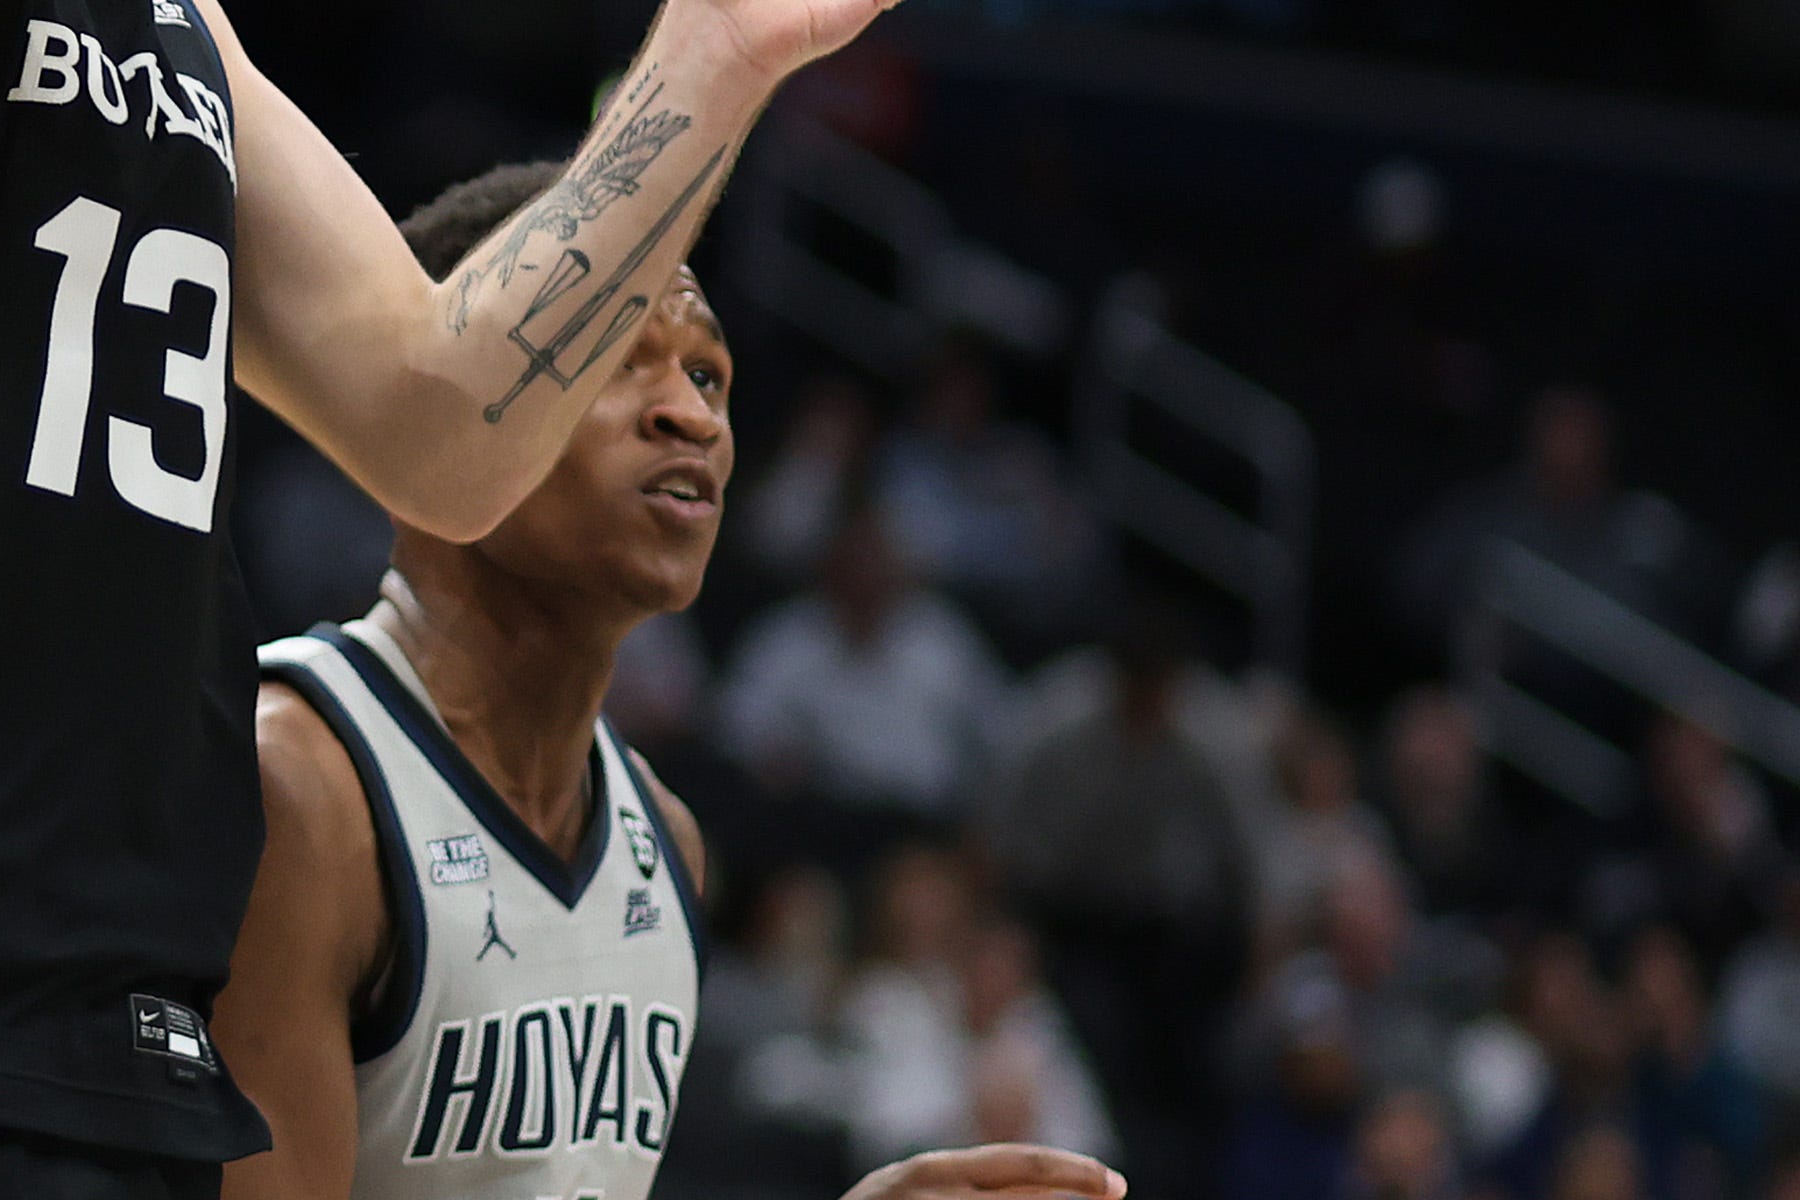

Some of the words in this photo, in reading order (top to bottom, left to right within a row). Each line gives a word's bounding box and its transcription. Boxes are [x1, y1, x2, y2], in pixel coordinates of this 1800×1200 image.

[6, 18, 238, 198] BUTLE
[25, 195, 231, 534] 13
[403, 995, 683, 1164] HOYAS
